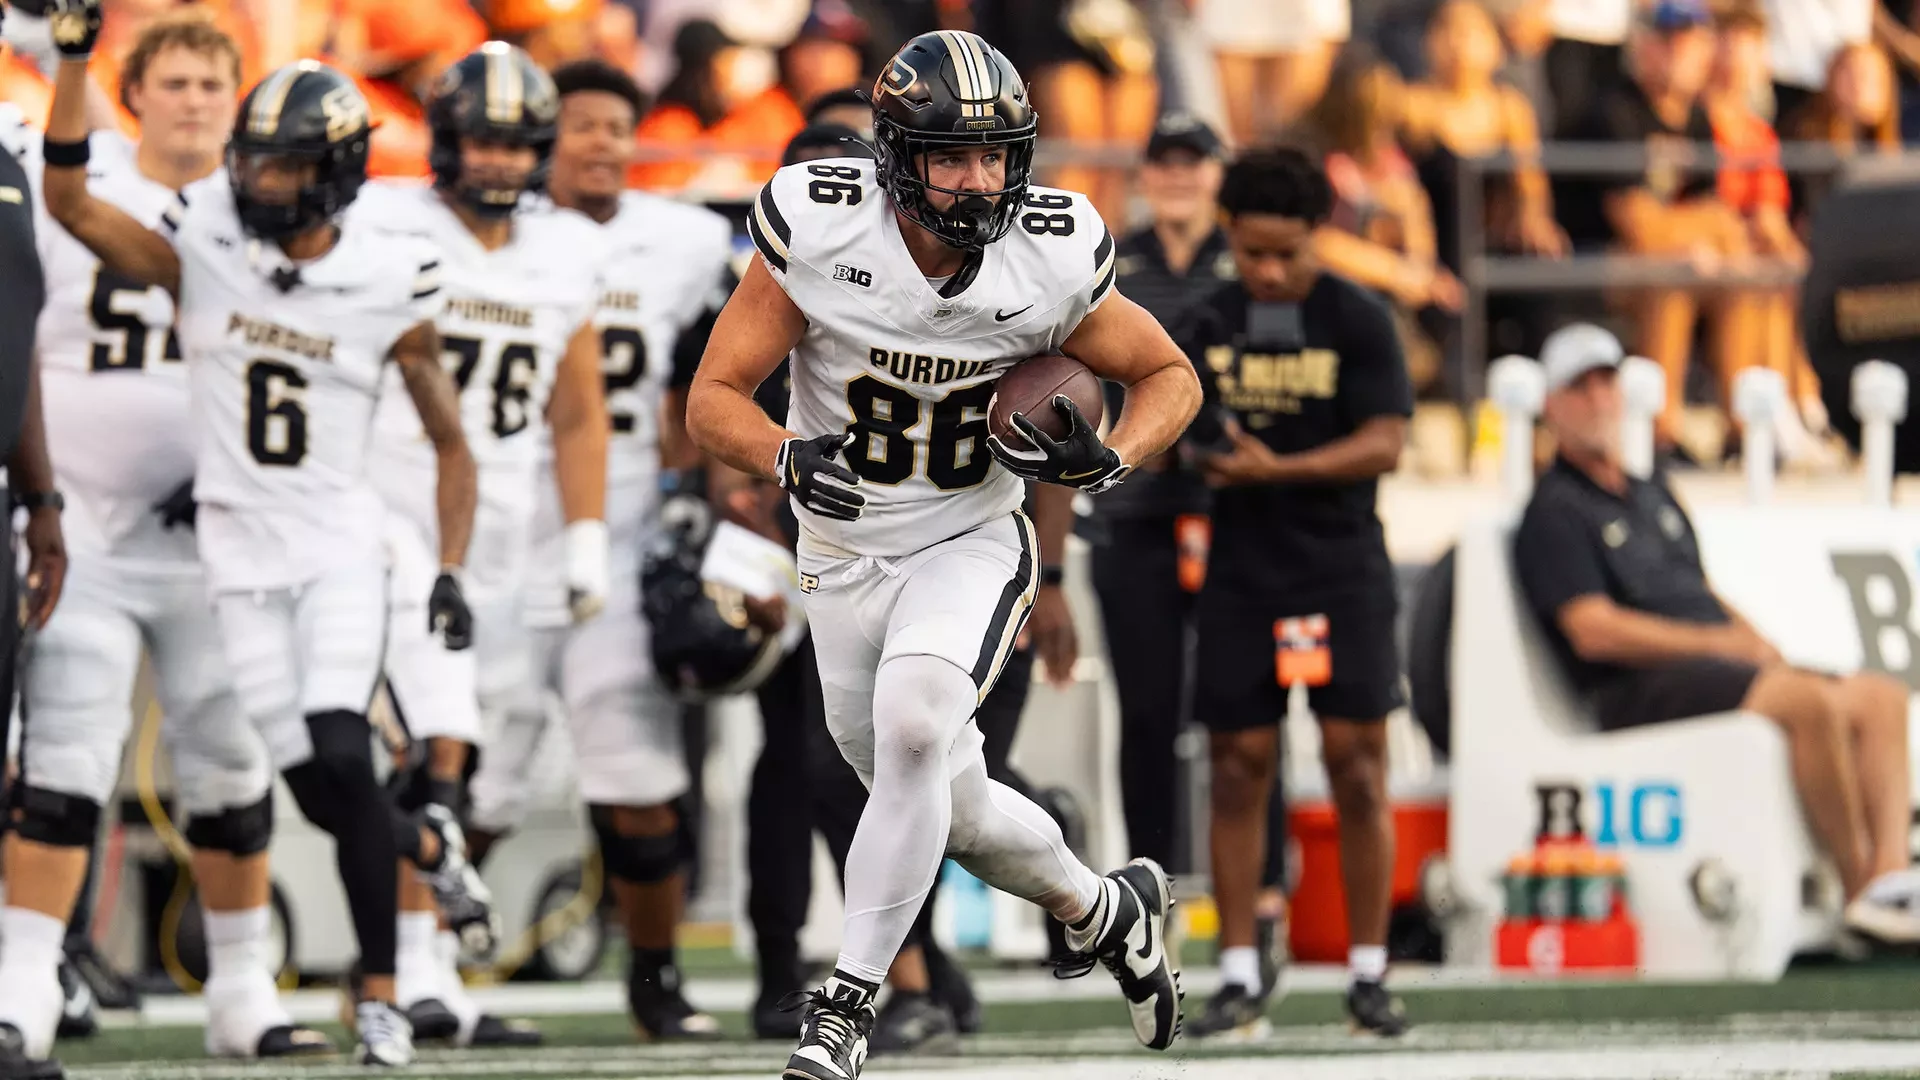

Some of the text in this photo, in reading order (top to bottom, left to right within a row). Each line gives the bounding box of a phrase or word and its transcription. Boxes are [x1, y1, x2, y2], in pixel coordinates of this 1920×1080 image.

[966, 119, 996, 131] PURDUE
[807, 163, 863, 206] 86
[1022, 192, 1075, 236] 86
[88, 256, 183, 374] 5
[442, 333, 538, 439] 76
[869, 346, 998, 386] PURDUE
[245, 357, 311, 468] 6
[842, 371, 996, 492] 86
